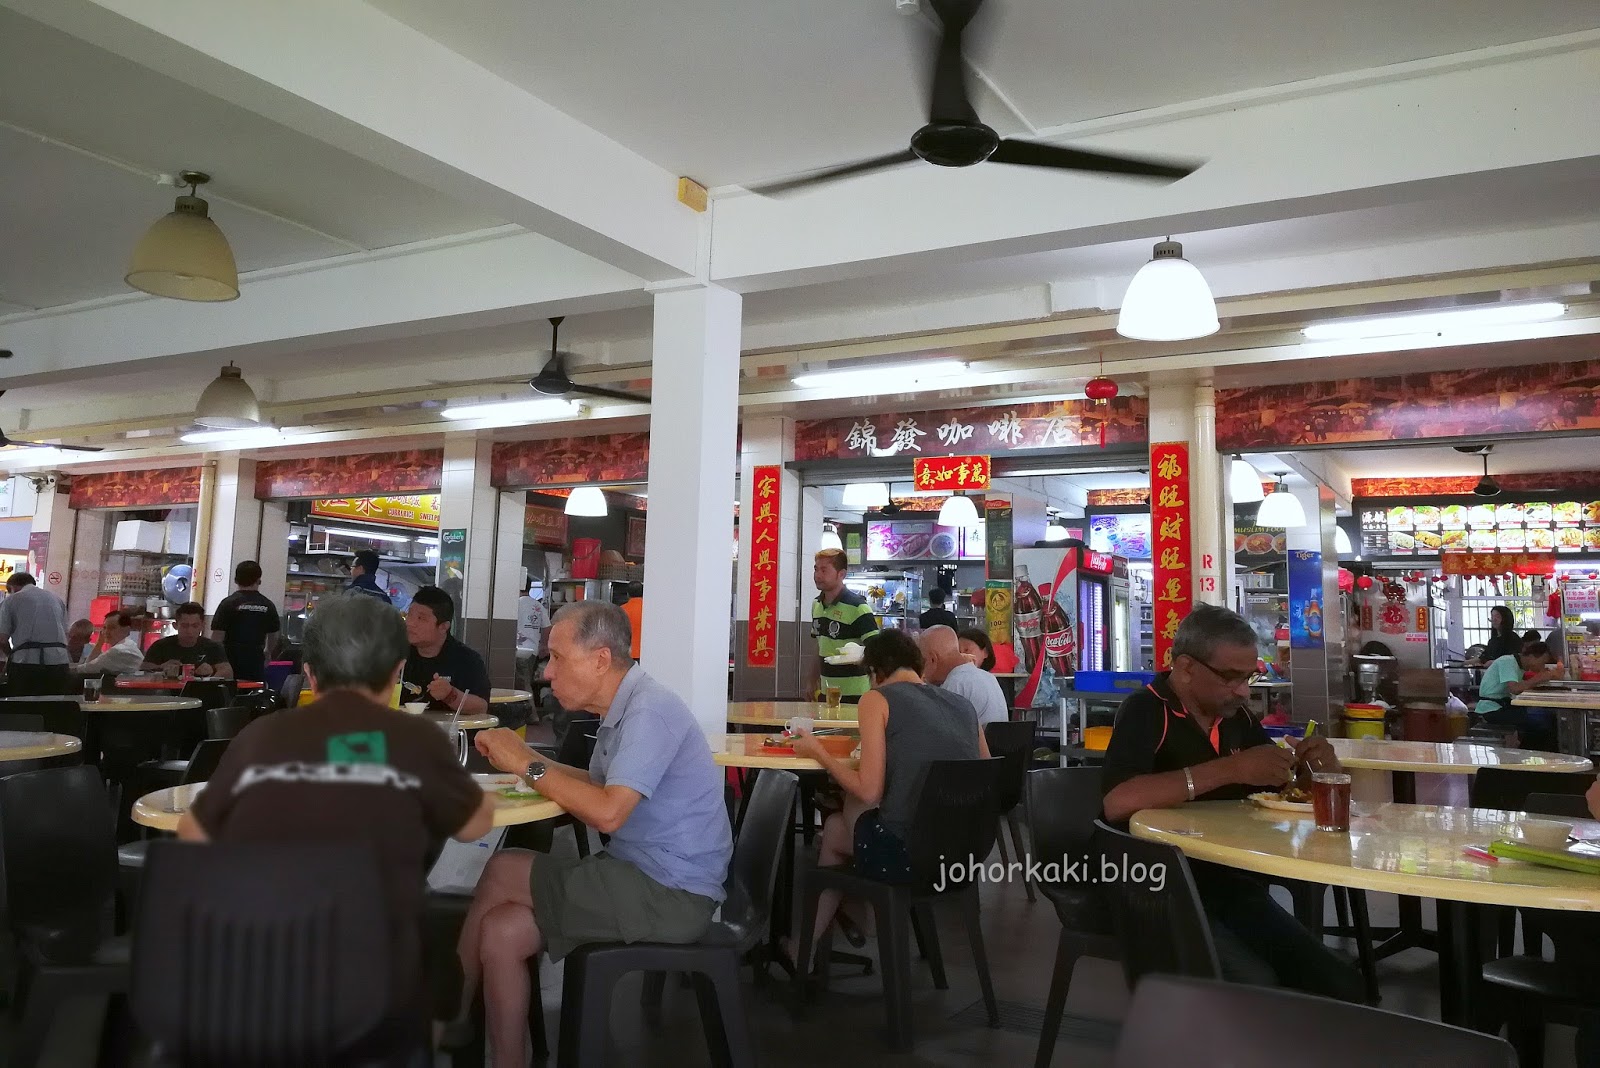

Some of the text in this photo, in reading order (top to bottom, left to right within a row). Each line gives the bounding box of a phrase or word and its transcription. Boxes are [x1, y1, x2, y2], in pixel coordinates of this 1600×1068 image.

[844, 410, 1075, 455] 錦發咖啡店
[1202, 554, 1213, 569] R
[1295, 551, 1314, 560] Tiger
[752, 475, 777, 658] 家興人興事業興
[1199, 577, 1215, 592] 13
[1045, 631, 1072, 648] Coca-Cola
